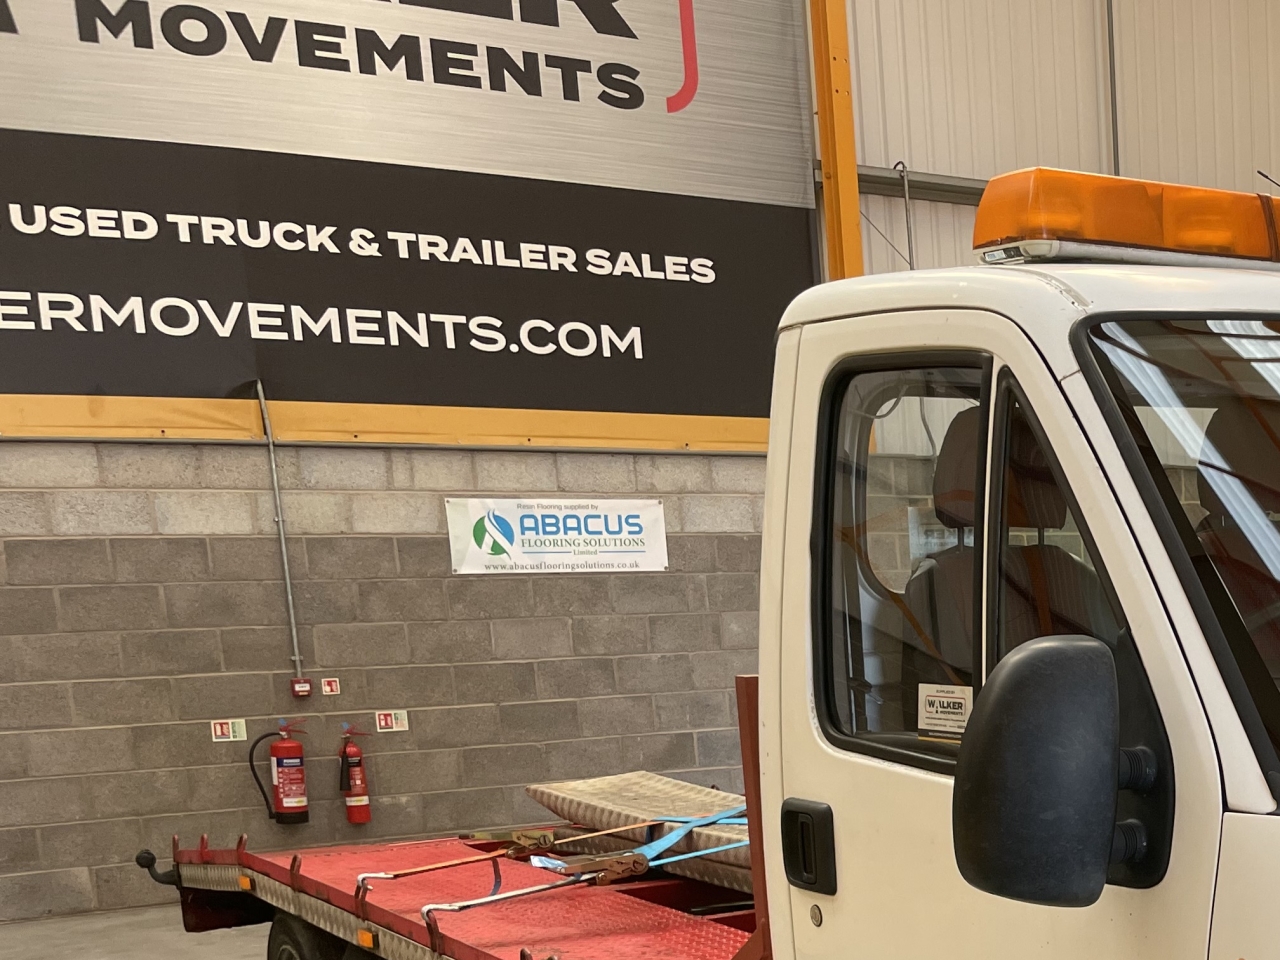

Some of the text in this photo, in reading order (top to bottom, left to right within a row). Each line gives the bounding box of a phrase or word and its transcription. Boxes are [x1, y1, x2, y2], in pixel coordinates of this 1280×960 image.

[75, 0, 645, 109] MOVEMENTS
[9, 203, 716, 284] USED TRUCK & TRAILER SALES
[537, 503, 563, 512] Flooring
[564, 503, 590, 511] supplied
[590, 503, 599, 511] by
[519, 513, 644, 536] ABACUS
[521, 537, 646, 548] FLOORING SOLUTIONS
[484, 560, 640, 572] www.abacusflooringsolutions.co.uk
